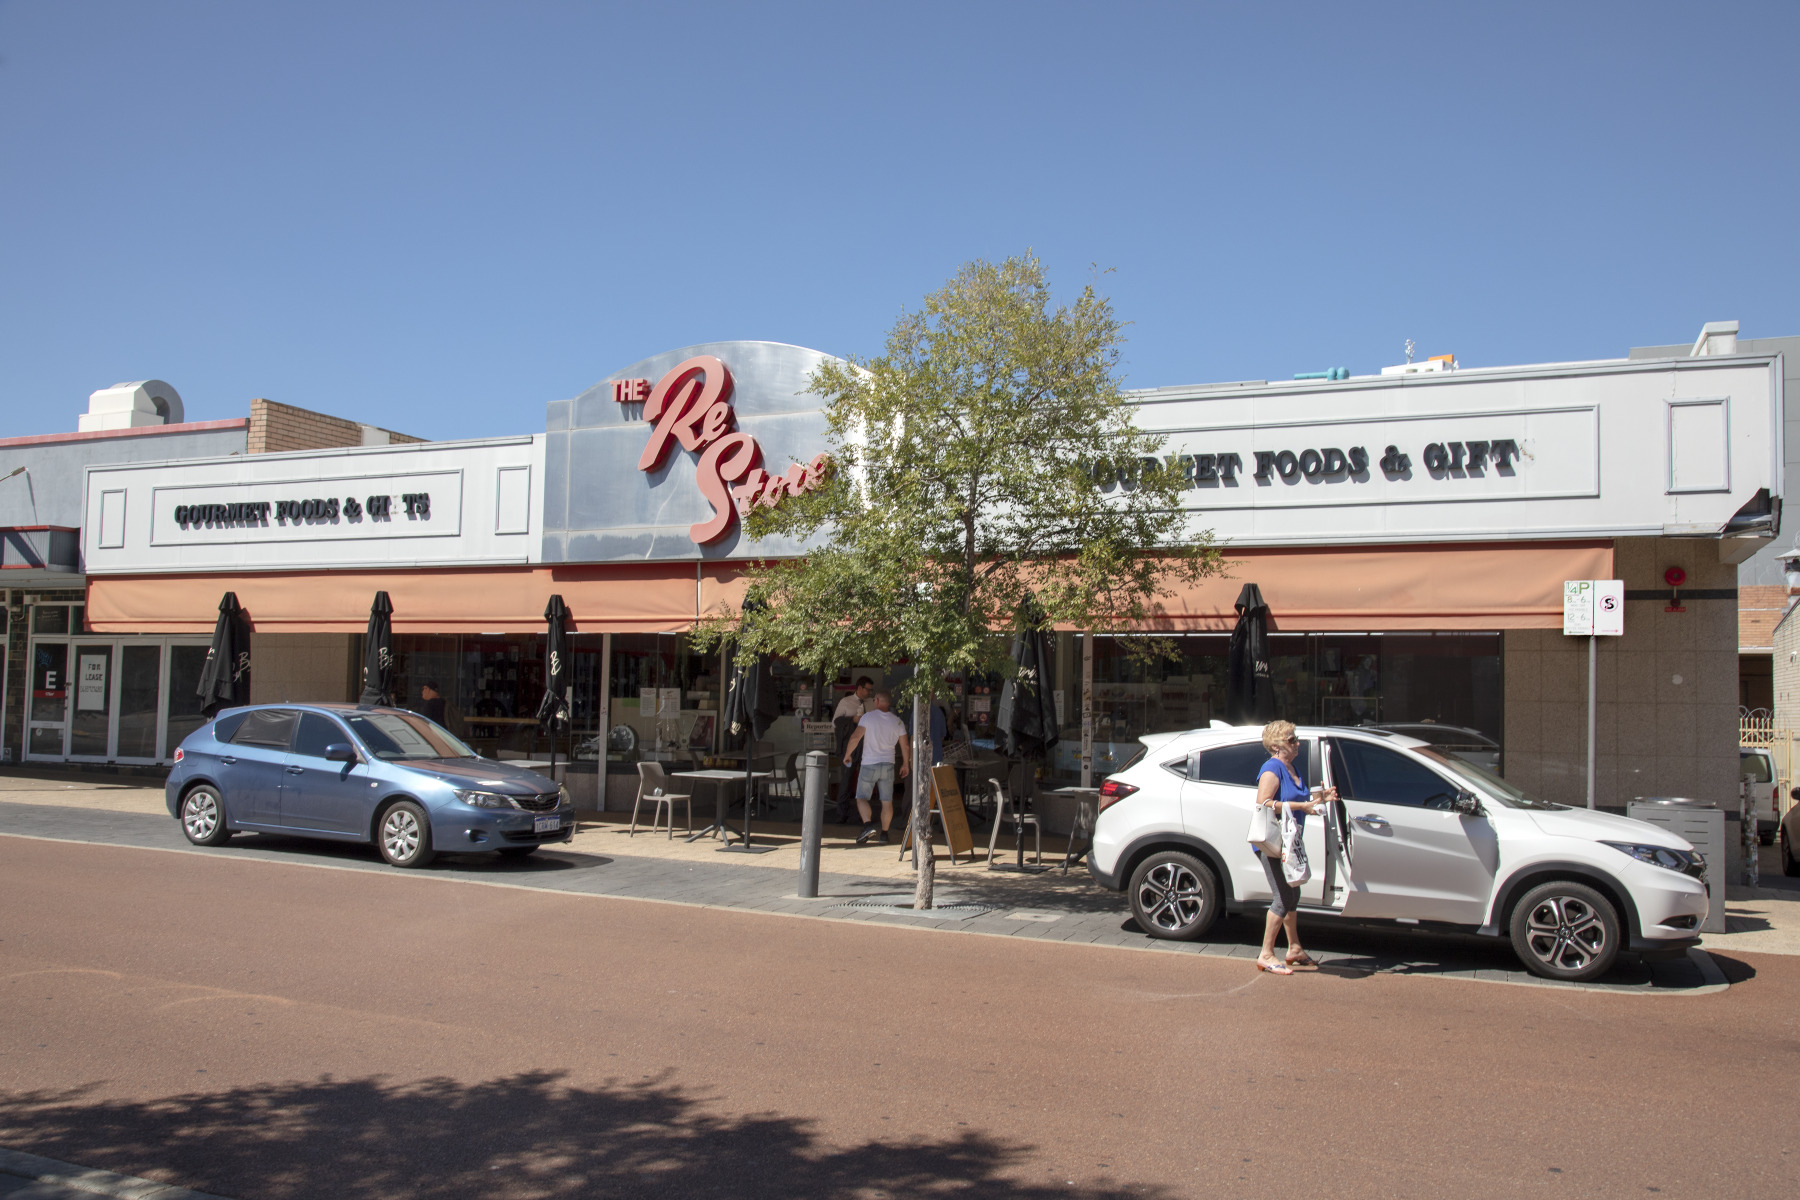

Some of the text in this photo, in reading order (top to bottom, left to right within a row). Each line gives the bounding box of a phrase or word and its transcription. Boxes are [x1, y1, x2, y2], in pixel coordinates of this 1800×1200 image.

[609, 354, 735, 472] THE Re
[1252, 446, 1370, 479] FOODS
[1379, 444, 1410, 474] &
[1422, 438, 1520, 471] GIFT
[689, 432, 832, 544] Store
[173, 501, 271, 525] GOURMET
[273, 497, 340, 521] FOODS
[342, 496, 362, 517] &
[85, 673, 103, 681] LEASE
[88, 663, 101, 671] FOR
